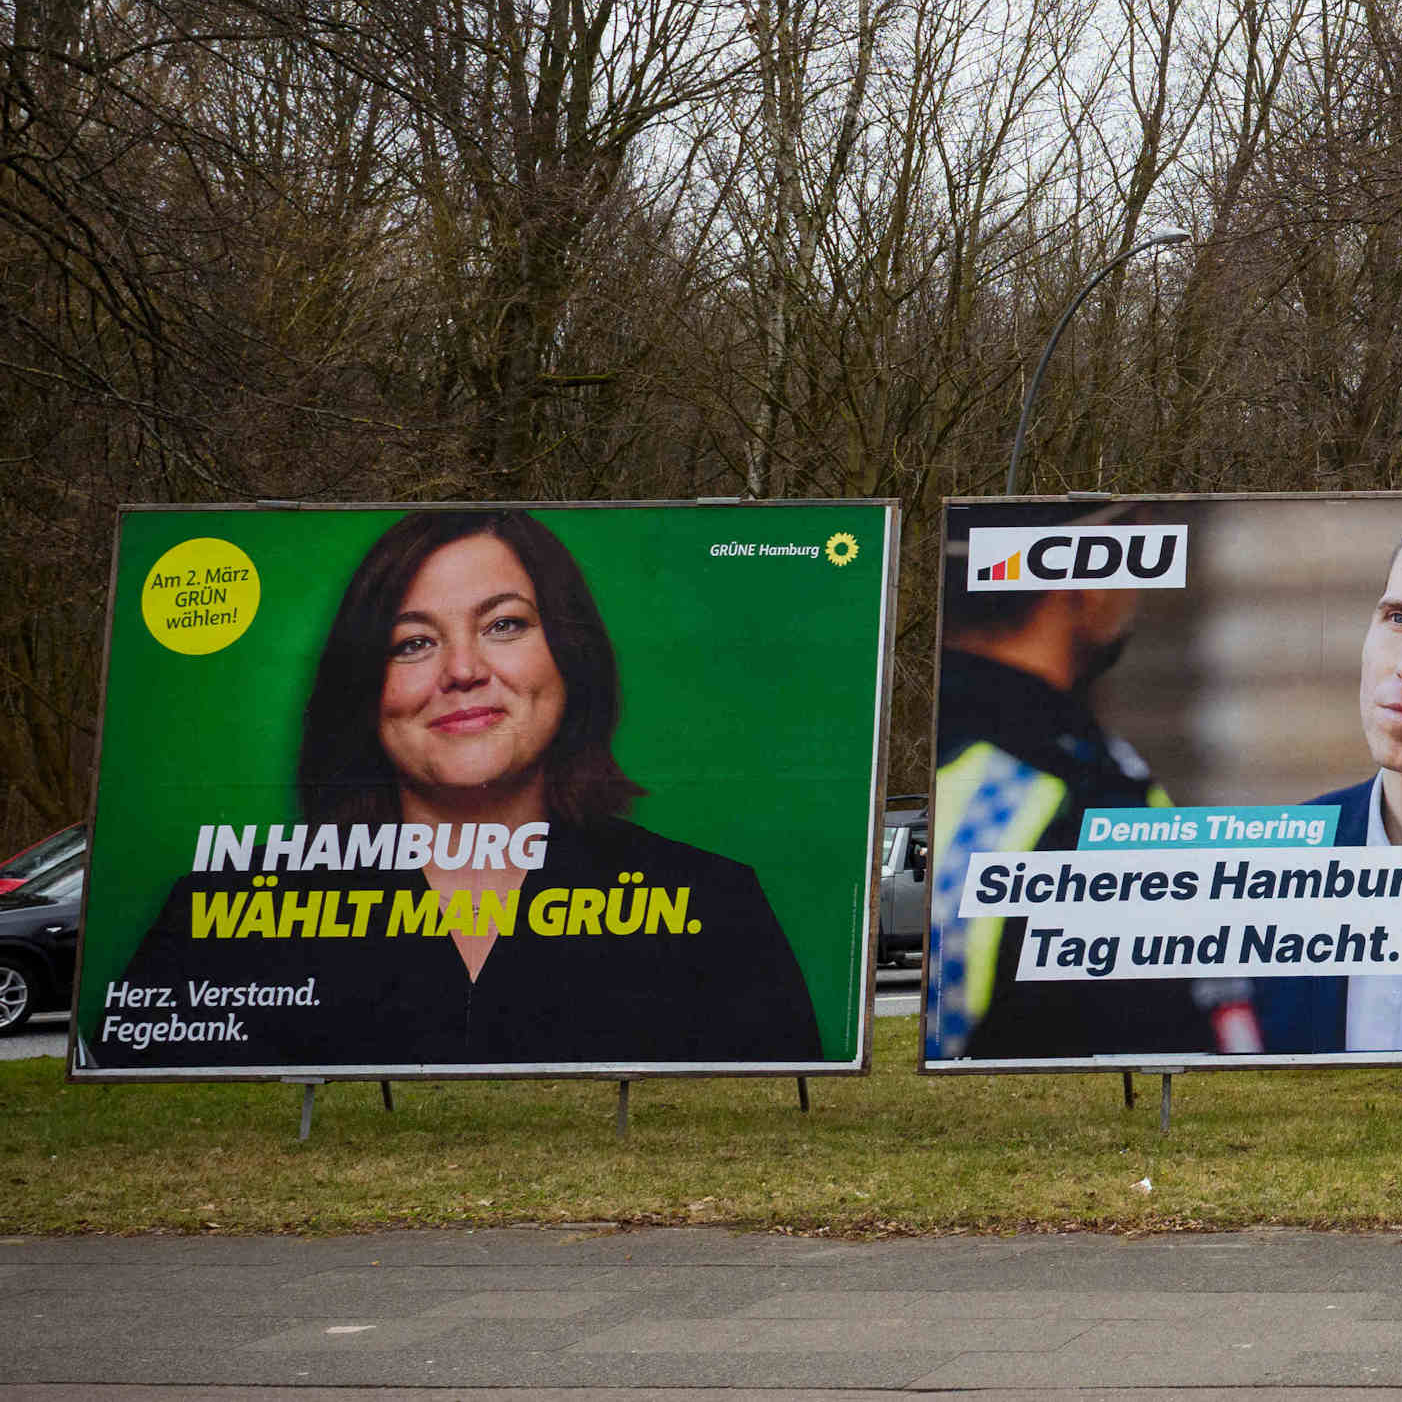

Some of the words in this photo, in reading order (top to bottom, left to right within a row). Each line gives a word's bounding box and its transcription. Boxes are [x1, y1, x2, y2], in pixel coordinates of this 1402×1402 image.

[710, 541, 756, 557] GRÜNE
[759, 543, 820, 559] Hamburg
[1026, 535, 1178, 580] CDU
[151, 573, 181, 590] Am
[186, 570, 201, 587] 2.
[205, 566, 249, 585] März
[175, 586, 227, 607] GRÜN
[166, 607, 238, 630] wählen!
[192, 824, 253, 872] IN
[262, 821, 549, 872] HAMBURG
[1088, 814, 1199, 843] Dennis
[1206, 813, 1326, 848] Thering
[975, 863, 1198, 905] Sicheres
[191, 875, 385, 939] WÄHLT
[389, 890, 521, 938] MAN
[529, 871, 702, 935] GRÜN.
[1031, 927, 1119, 976] Tag
[1131, 925, 1226, 966] und
[1239, 923, 1399, 966] Nacht.
[105, 981, 176, 1009] Herz.
[188, 978, 321, 1008] Verstand.
[102, 1012, 250, 1047] Fegebank.
